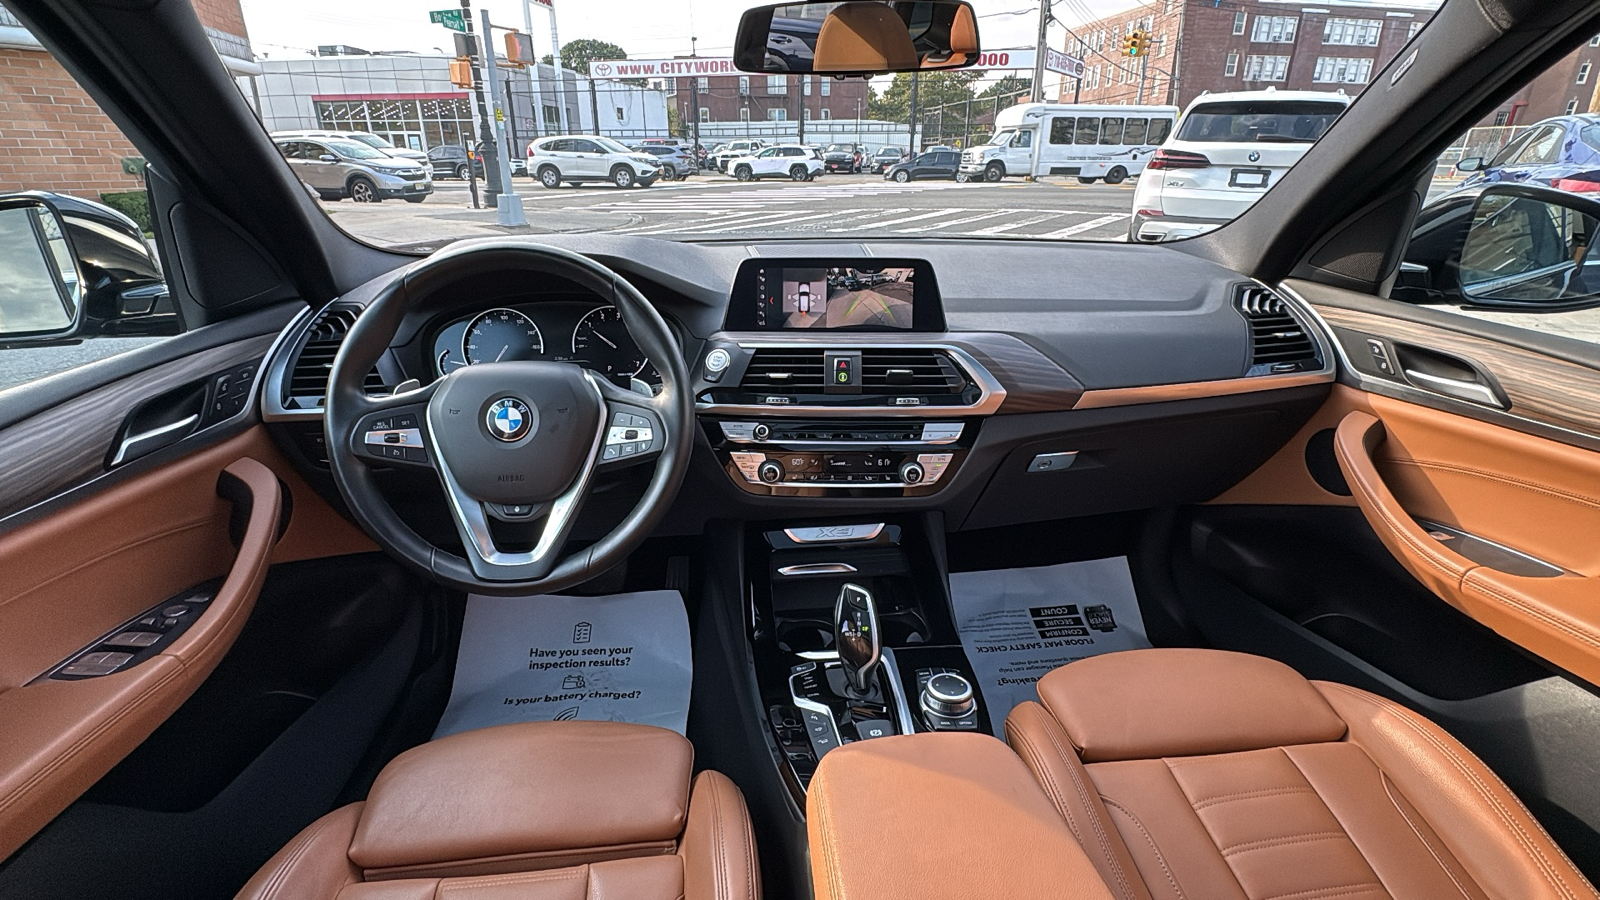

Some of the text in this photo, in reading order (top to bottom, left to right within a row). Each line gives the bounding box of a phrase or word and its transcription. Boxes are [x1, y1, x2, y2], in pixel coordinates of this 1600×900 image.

[977, 52, 1009, 66] 000
[616, 60, 739, 75] WWW.CITYWORL
[491, 400, 527, 413] BMW
[497, 474, 525, 483] AIRBAG
[1040, 606, 1068, 616] COUNT
[1043, 618, 1074, 627] SECURE
[1045, 628, 1083, 638] CONFIRM
[976, 638, 1094, 653] FLOOR MAT SAFETY CHECK
[529, 646, 633, 660] Have you seen your
[529, 657, 631, 671] inspection results?
[503, 690, 642, 707] Is your battery charged?
